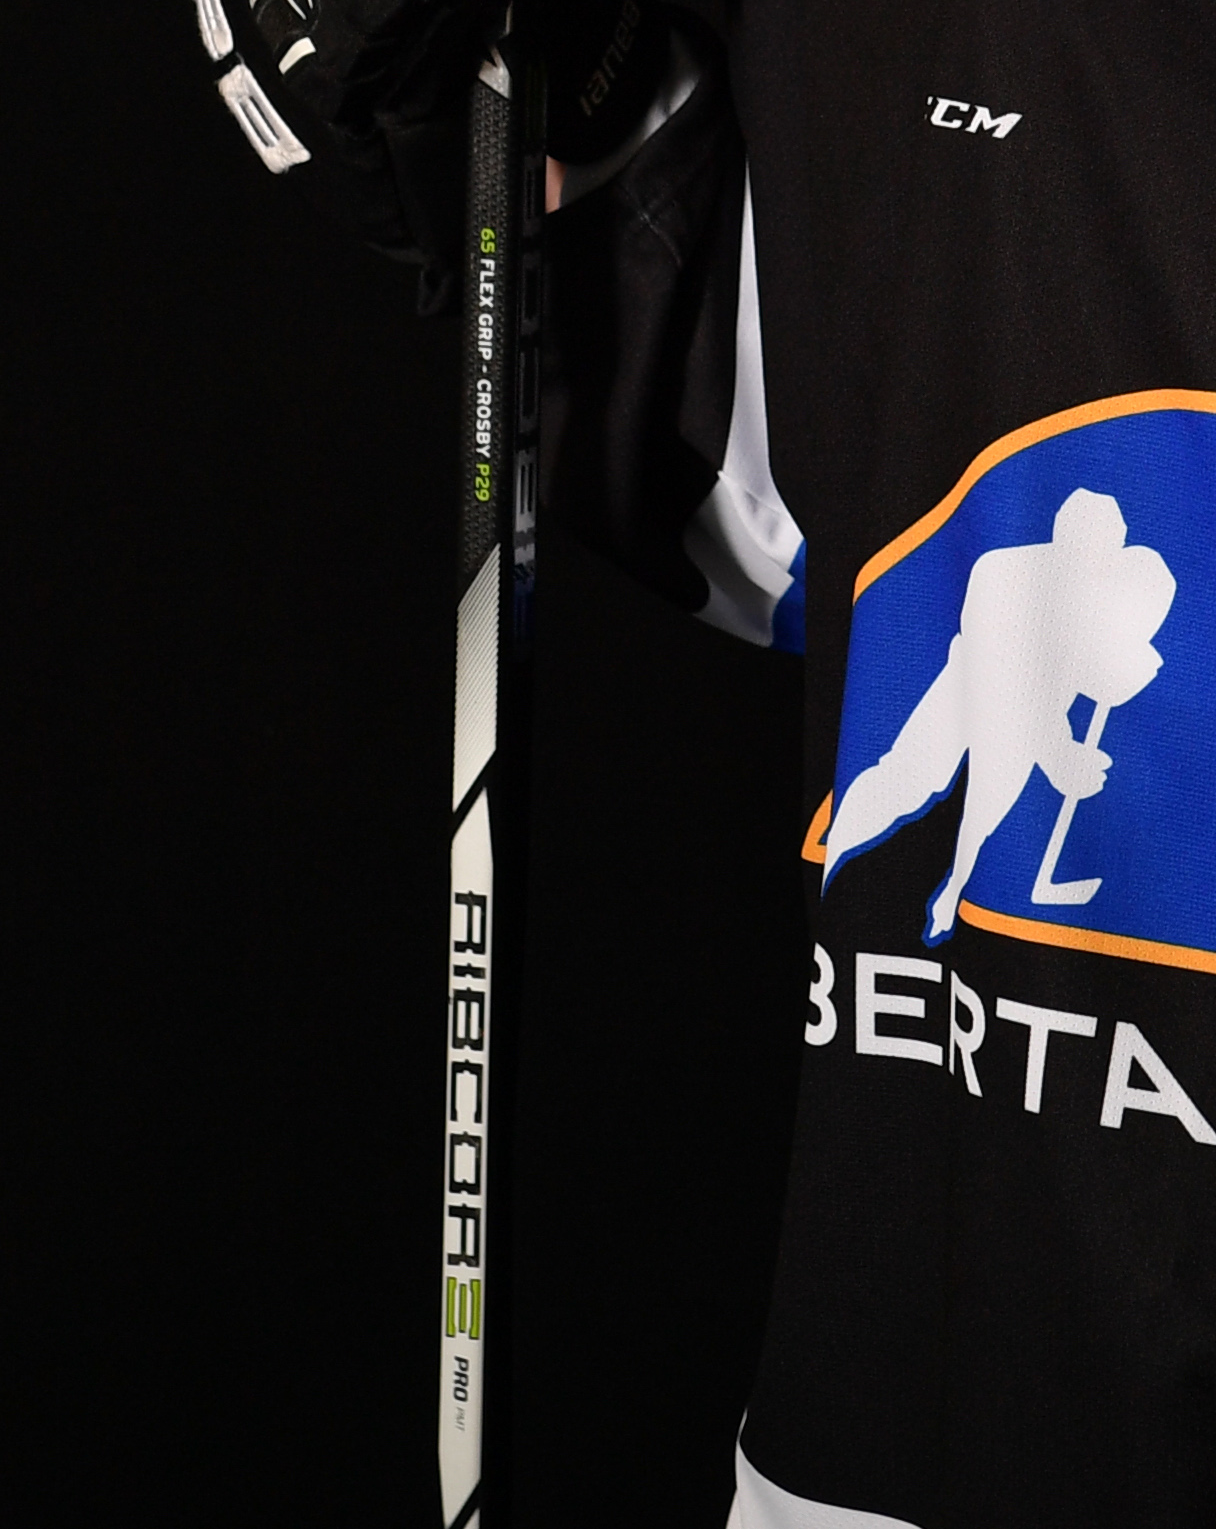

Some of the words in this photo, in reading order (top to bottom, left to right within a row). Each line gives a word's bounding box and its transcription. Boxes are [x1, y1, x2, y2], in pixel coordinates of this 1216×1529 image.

[924, 95, 1024, 139] CM
[479, 227, 496, 253] 65
[478, 258, 496, 308] FLEX
[477, 313, 494, 361] GRIP
[474, 378, 493, 459] CROSBY
[474, 462, 491, 502] P29
[445, 890, 488, 1340] RIBCORE
[452, 1355, 470, 1403] PRO
